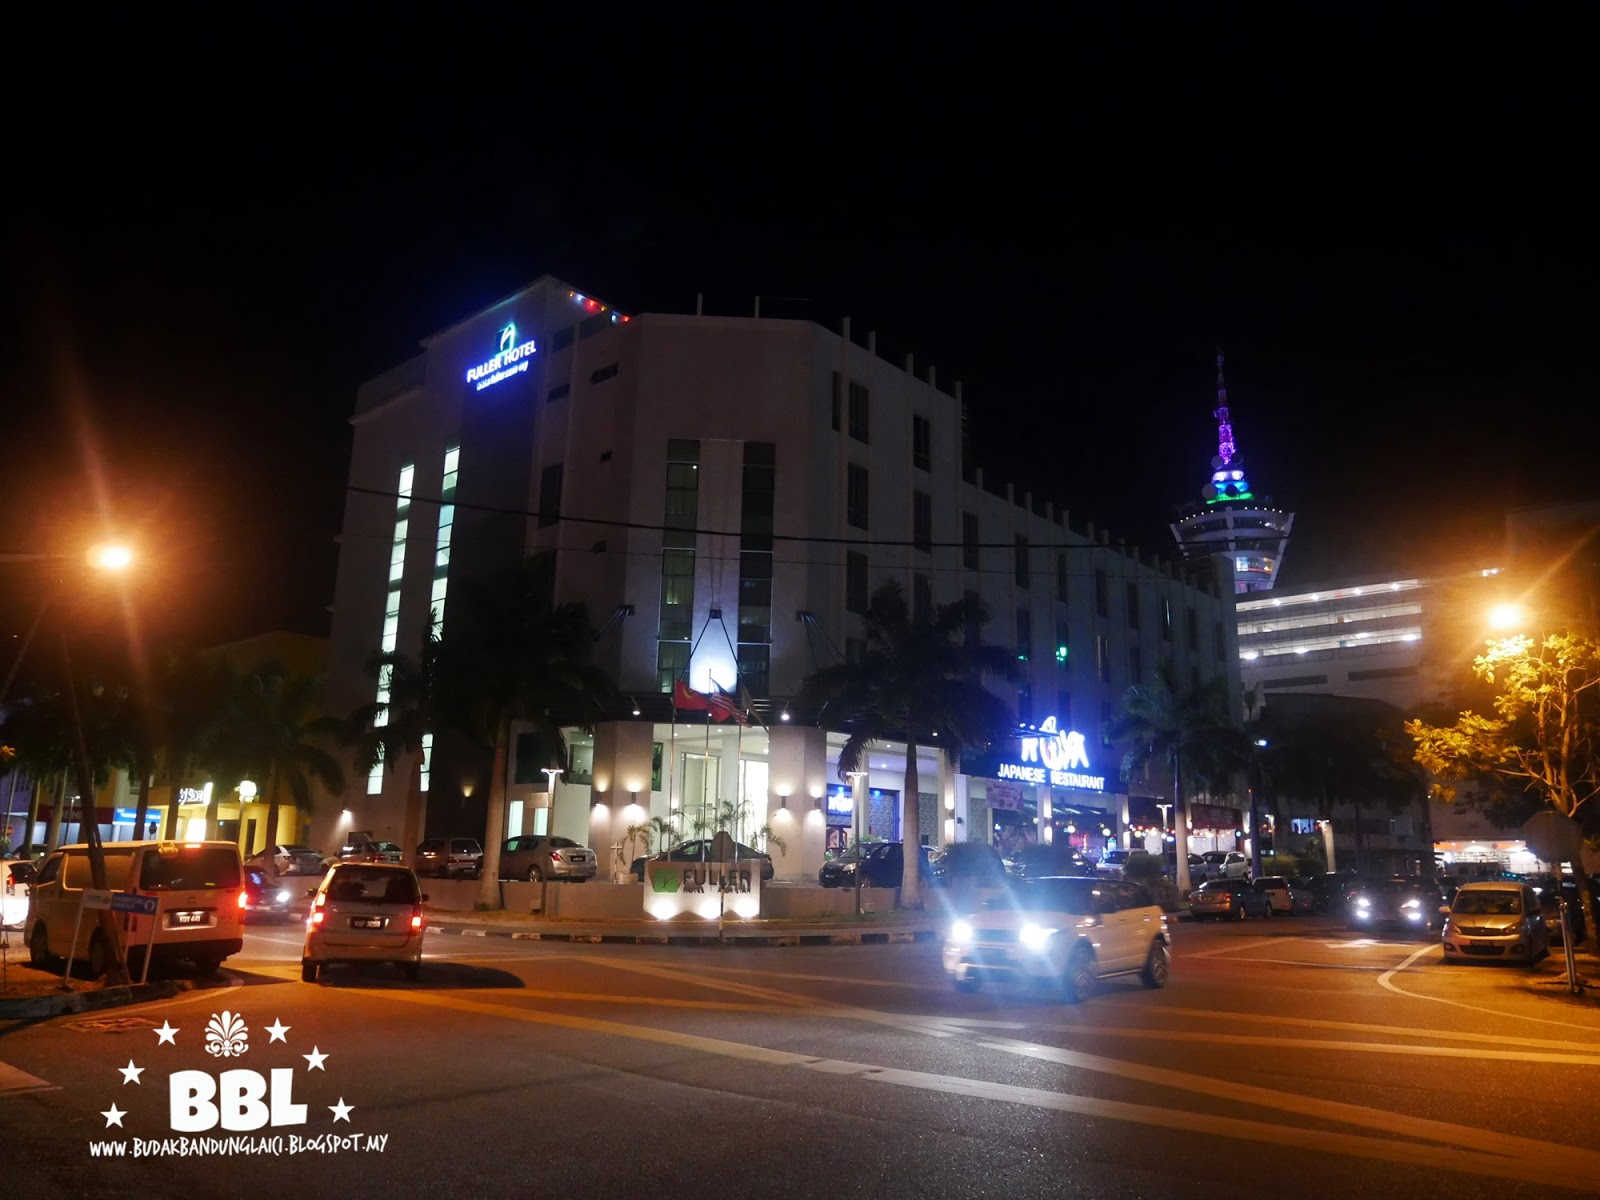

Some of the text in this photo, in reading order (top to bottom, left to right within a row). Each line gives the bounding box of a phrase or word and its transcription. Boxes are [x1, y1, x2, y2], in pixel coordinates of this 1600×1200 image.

[467, 354, 502, 383] FULLER
[504, 340, 537, 366] HOTEL
[998, 763, 1105, 790] JAPANESE RESTAURANT
[683, 868, 752, 886] FULLER
